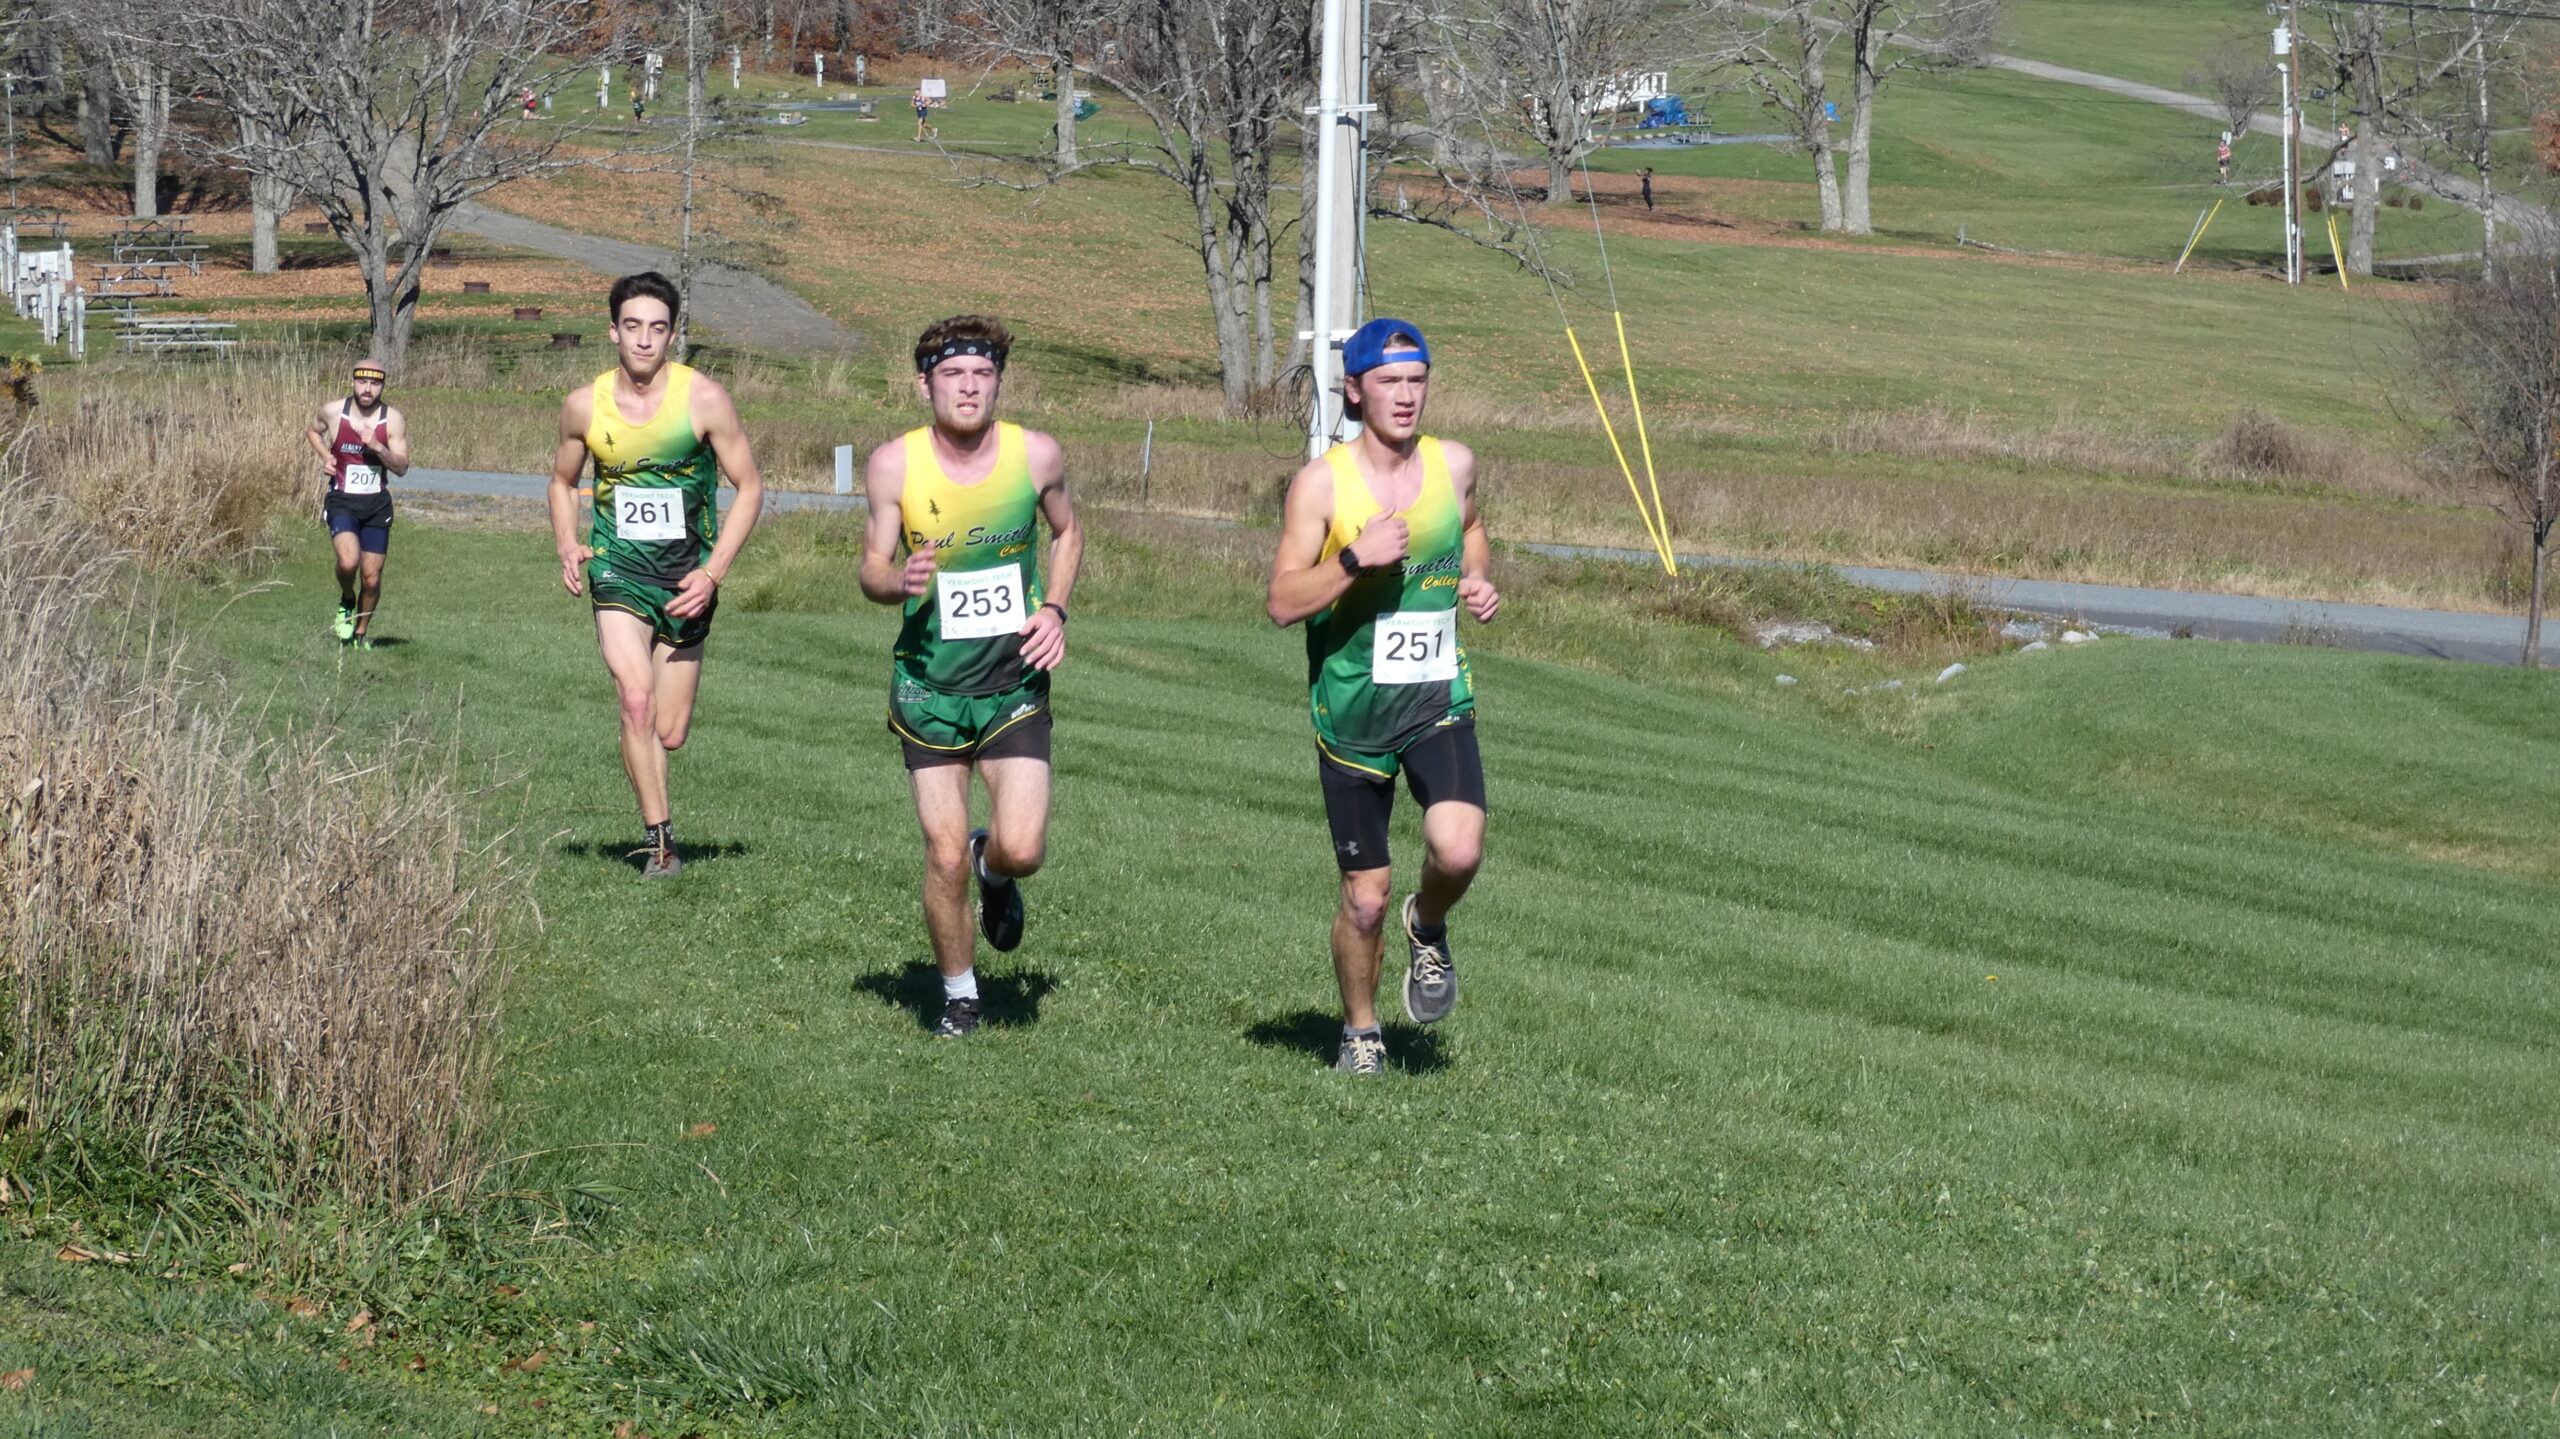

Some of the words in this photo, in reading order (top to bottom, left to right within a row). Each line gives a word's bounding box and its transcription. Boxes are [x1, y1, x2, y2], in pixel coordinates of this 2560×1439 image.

[351, 472, 377, 485] 207
[621, 492, 657, 500] VERMONT
[623, 501, 670, 523] 261
[947, 577, 989, 587] VERMONT
[992, 572, 1013, 582] TECH
[950, 585, 1012, 618] 253
[1385, 618, 1430, 627] VERMONT
[1386, 629, 1443, 661] 251
